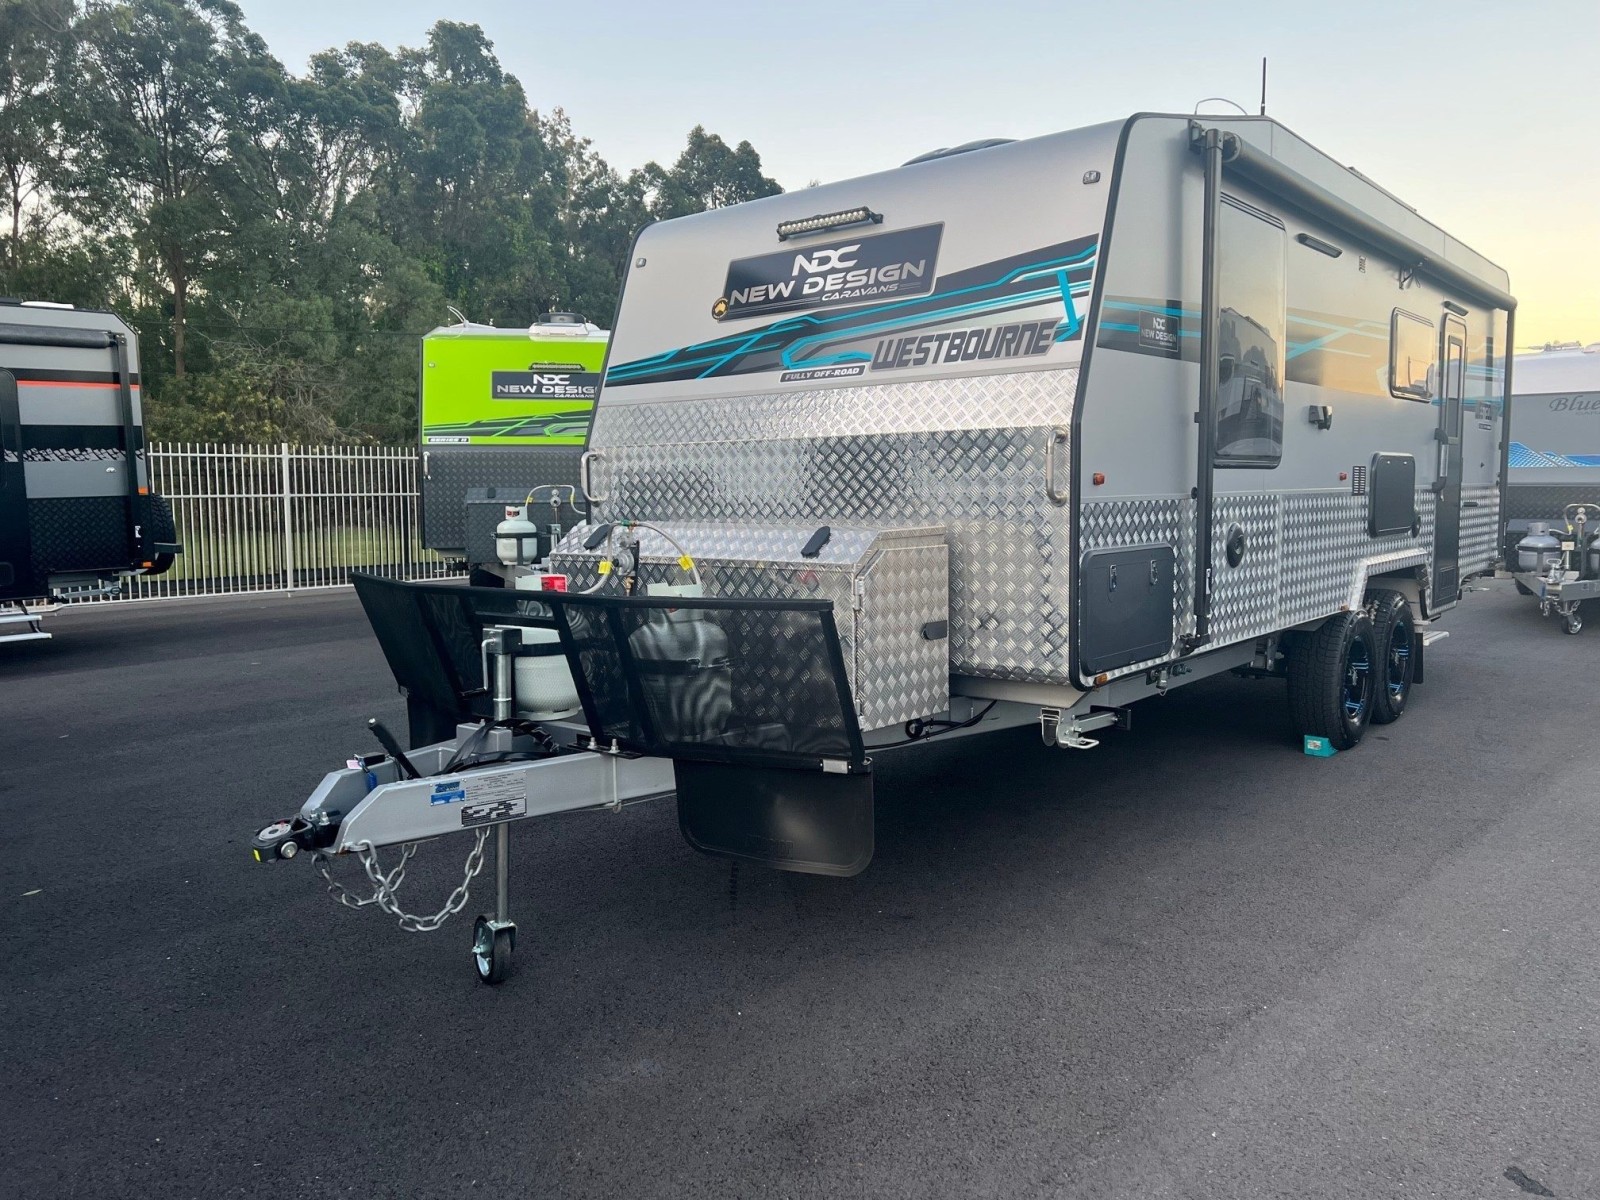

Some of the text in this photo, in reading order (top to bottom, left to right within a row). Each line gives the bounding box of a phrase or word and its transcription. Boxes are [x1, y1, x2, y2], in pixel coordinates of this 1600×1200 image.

[791, 244, 861, 276] NDC
[730, 259, 926, 306] NEW DESIGN
[821, 283, 899, 301] CARAVANS
[1153, 317, 1165, 330] NDC
[1156, 331, 1176, 342] DESIGN
[873, 320, 1059, 370] WESTBOURNE
[533, 374, 570, 385] NDC
[784, 367, 860, 381] FULLY OFF-ROAD
[496, 385, 598, 394] NEW DESIG
[1549, 394, 1600, 411] Blue
